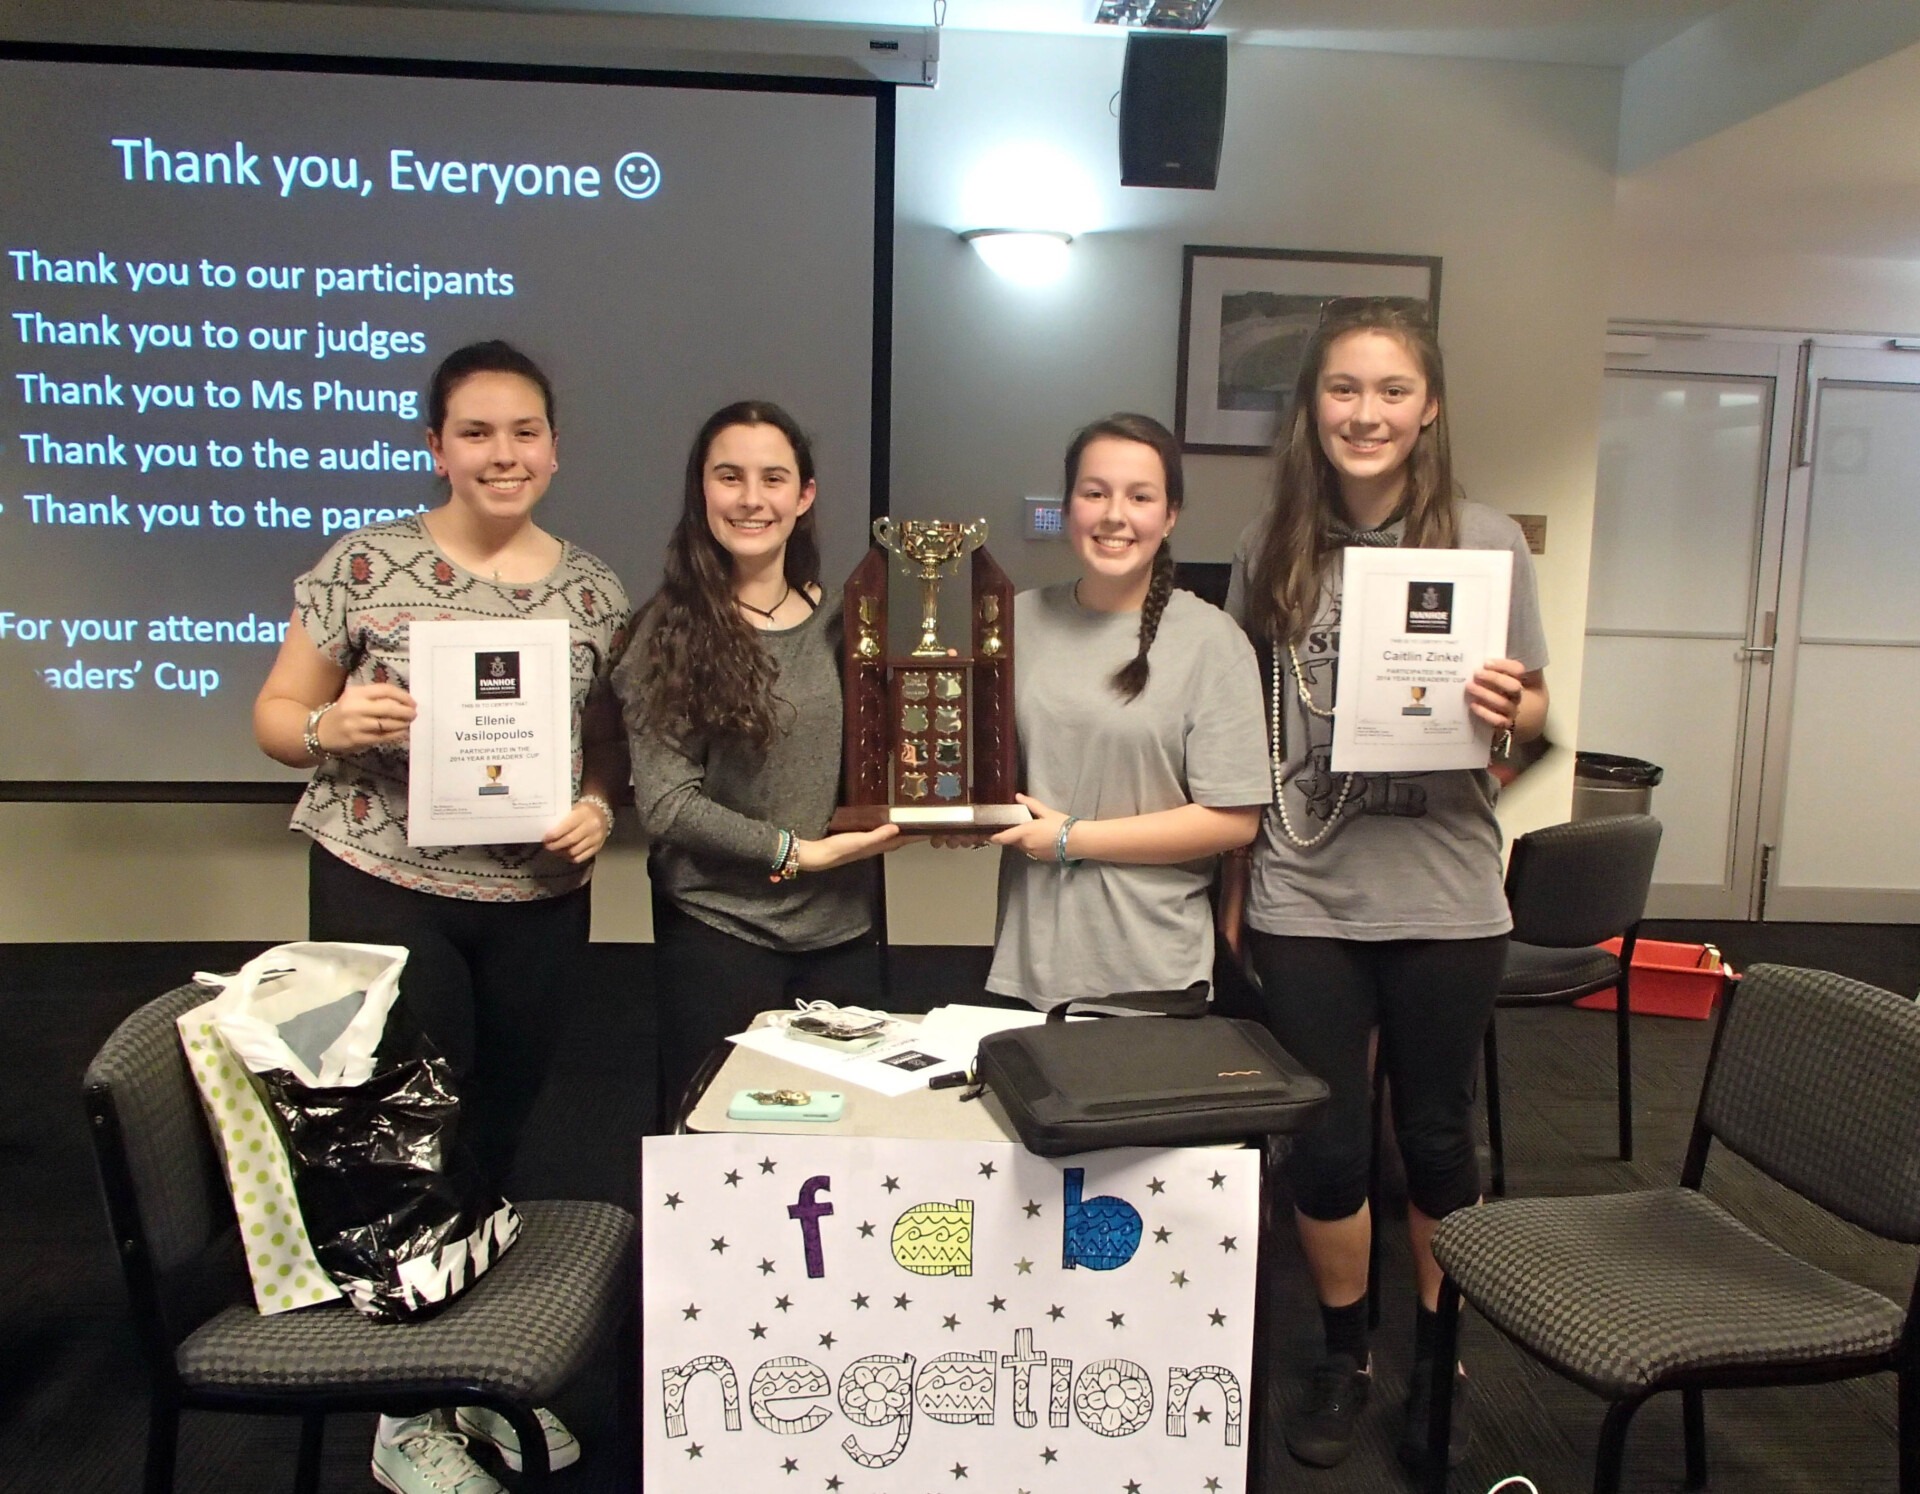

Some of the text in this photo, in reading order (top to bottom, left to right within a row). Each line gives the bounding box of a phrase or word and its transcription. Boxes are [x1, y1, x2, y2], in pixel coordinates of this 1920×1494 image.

[111, 137, 600, 204] Thank you, Everyone
[8, 250, 514, 300] Thank you to our participants
[12, 312, 426, 360] Thank you to our judges
[16, 373, 418, 420] Thank you to Ms Phung
[20, 433, 436, 472] Thank you to the audien
[23, 494, 429, 535] Thank you to the pare
[0, 612, 52, 640] For
[61, 619, 138, 647] your
[1383, 650, 1463, 662] Caitlin Zinkel
[44, 659, 219, 697] aders' Cup
[480, 678, 516, 687] IVANHOE
[455, 729, 534, 742] Vasilopoulos
[475, 714, 516, 726] Ellenie
[460, 747, 508, 755] PARTICIPATED
[397, 1196, 524, 1312] MYE
[661, 1327, 1242, 1469] negation
